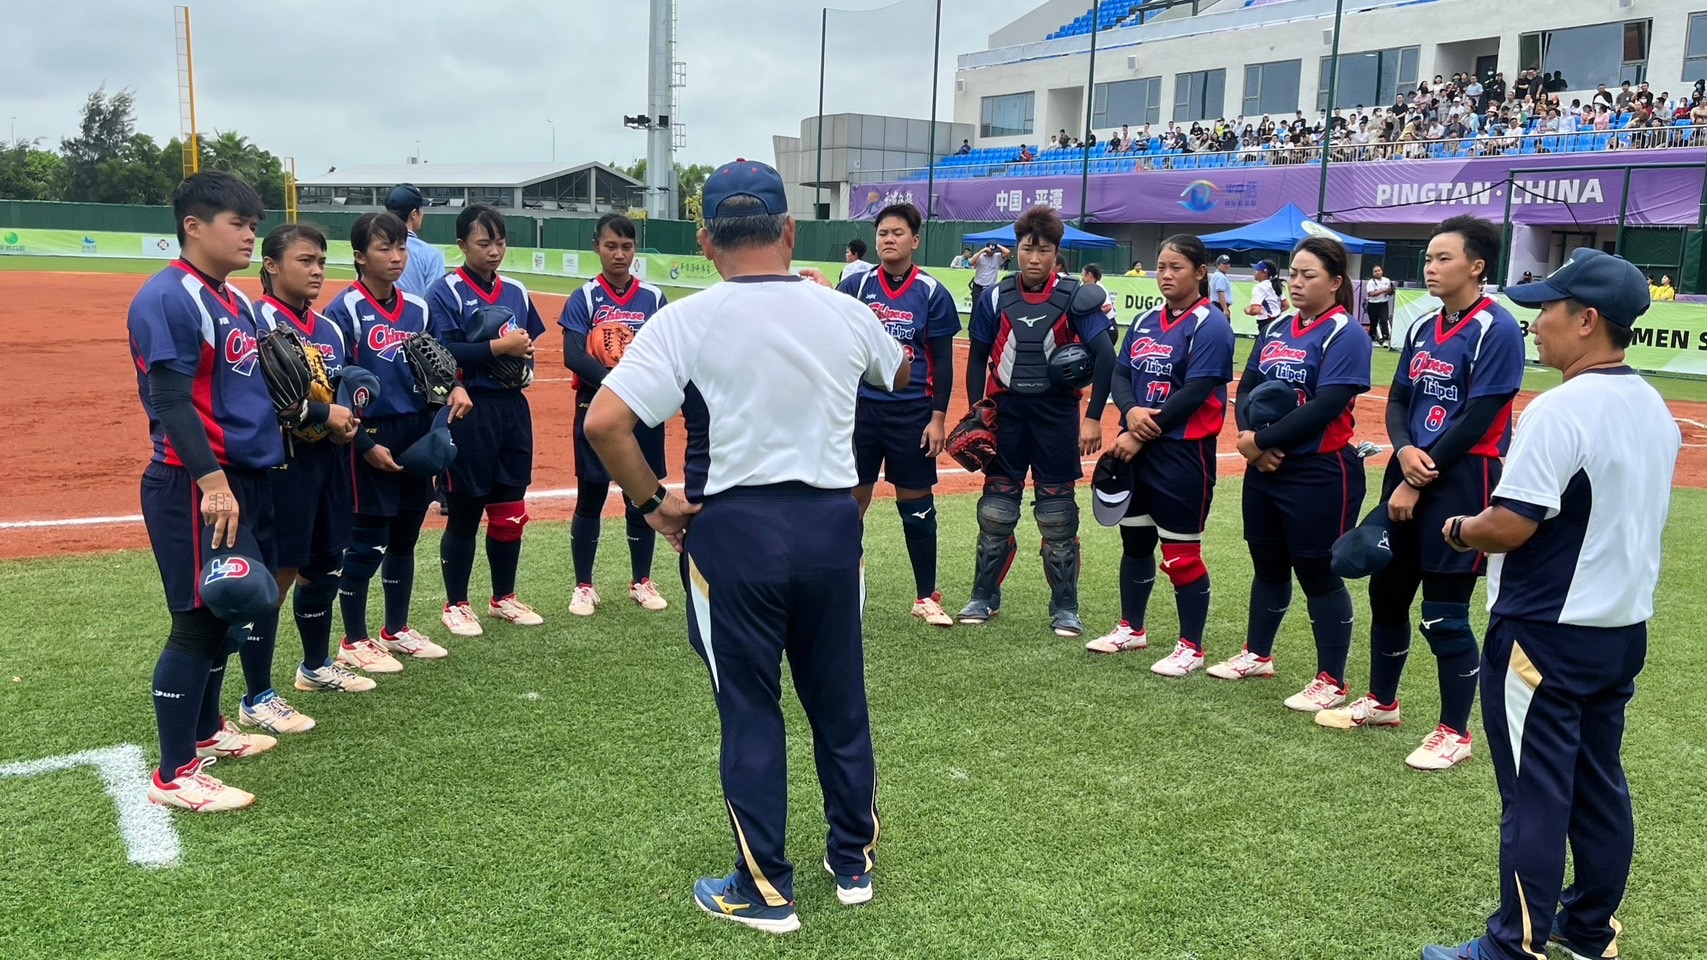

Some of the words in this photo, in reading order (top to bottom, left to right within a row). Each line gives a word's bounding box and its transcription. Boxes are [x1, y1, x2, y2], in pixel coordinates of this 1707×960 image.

[1376, 181, 1491, 206] PINGTAN
[1510, 178, 1604, 204] CHINA
[1131, 336, 1173, 358] Chinese
[1260, 340, 1307, 362] Chinese
[1145, 358, 1173, 376] Taipei
[1275, 362, 1307, 384] Taipei
[1408, 350, 1454, 380] Chinese
[1145, 380, 1171, 403] 17
[1423, 377, 1458, 402] Taipei
[1424, 405, 1447, 432] 8
